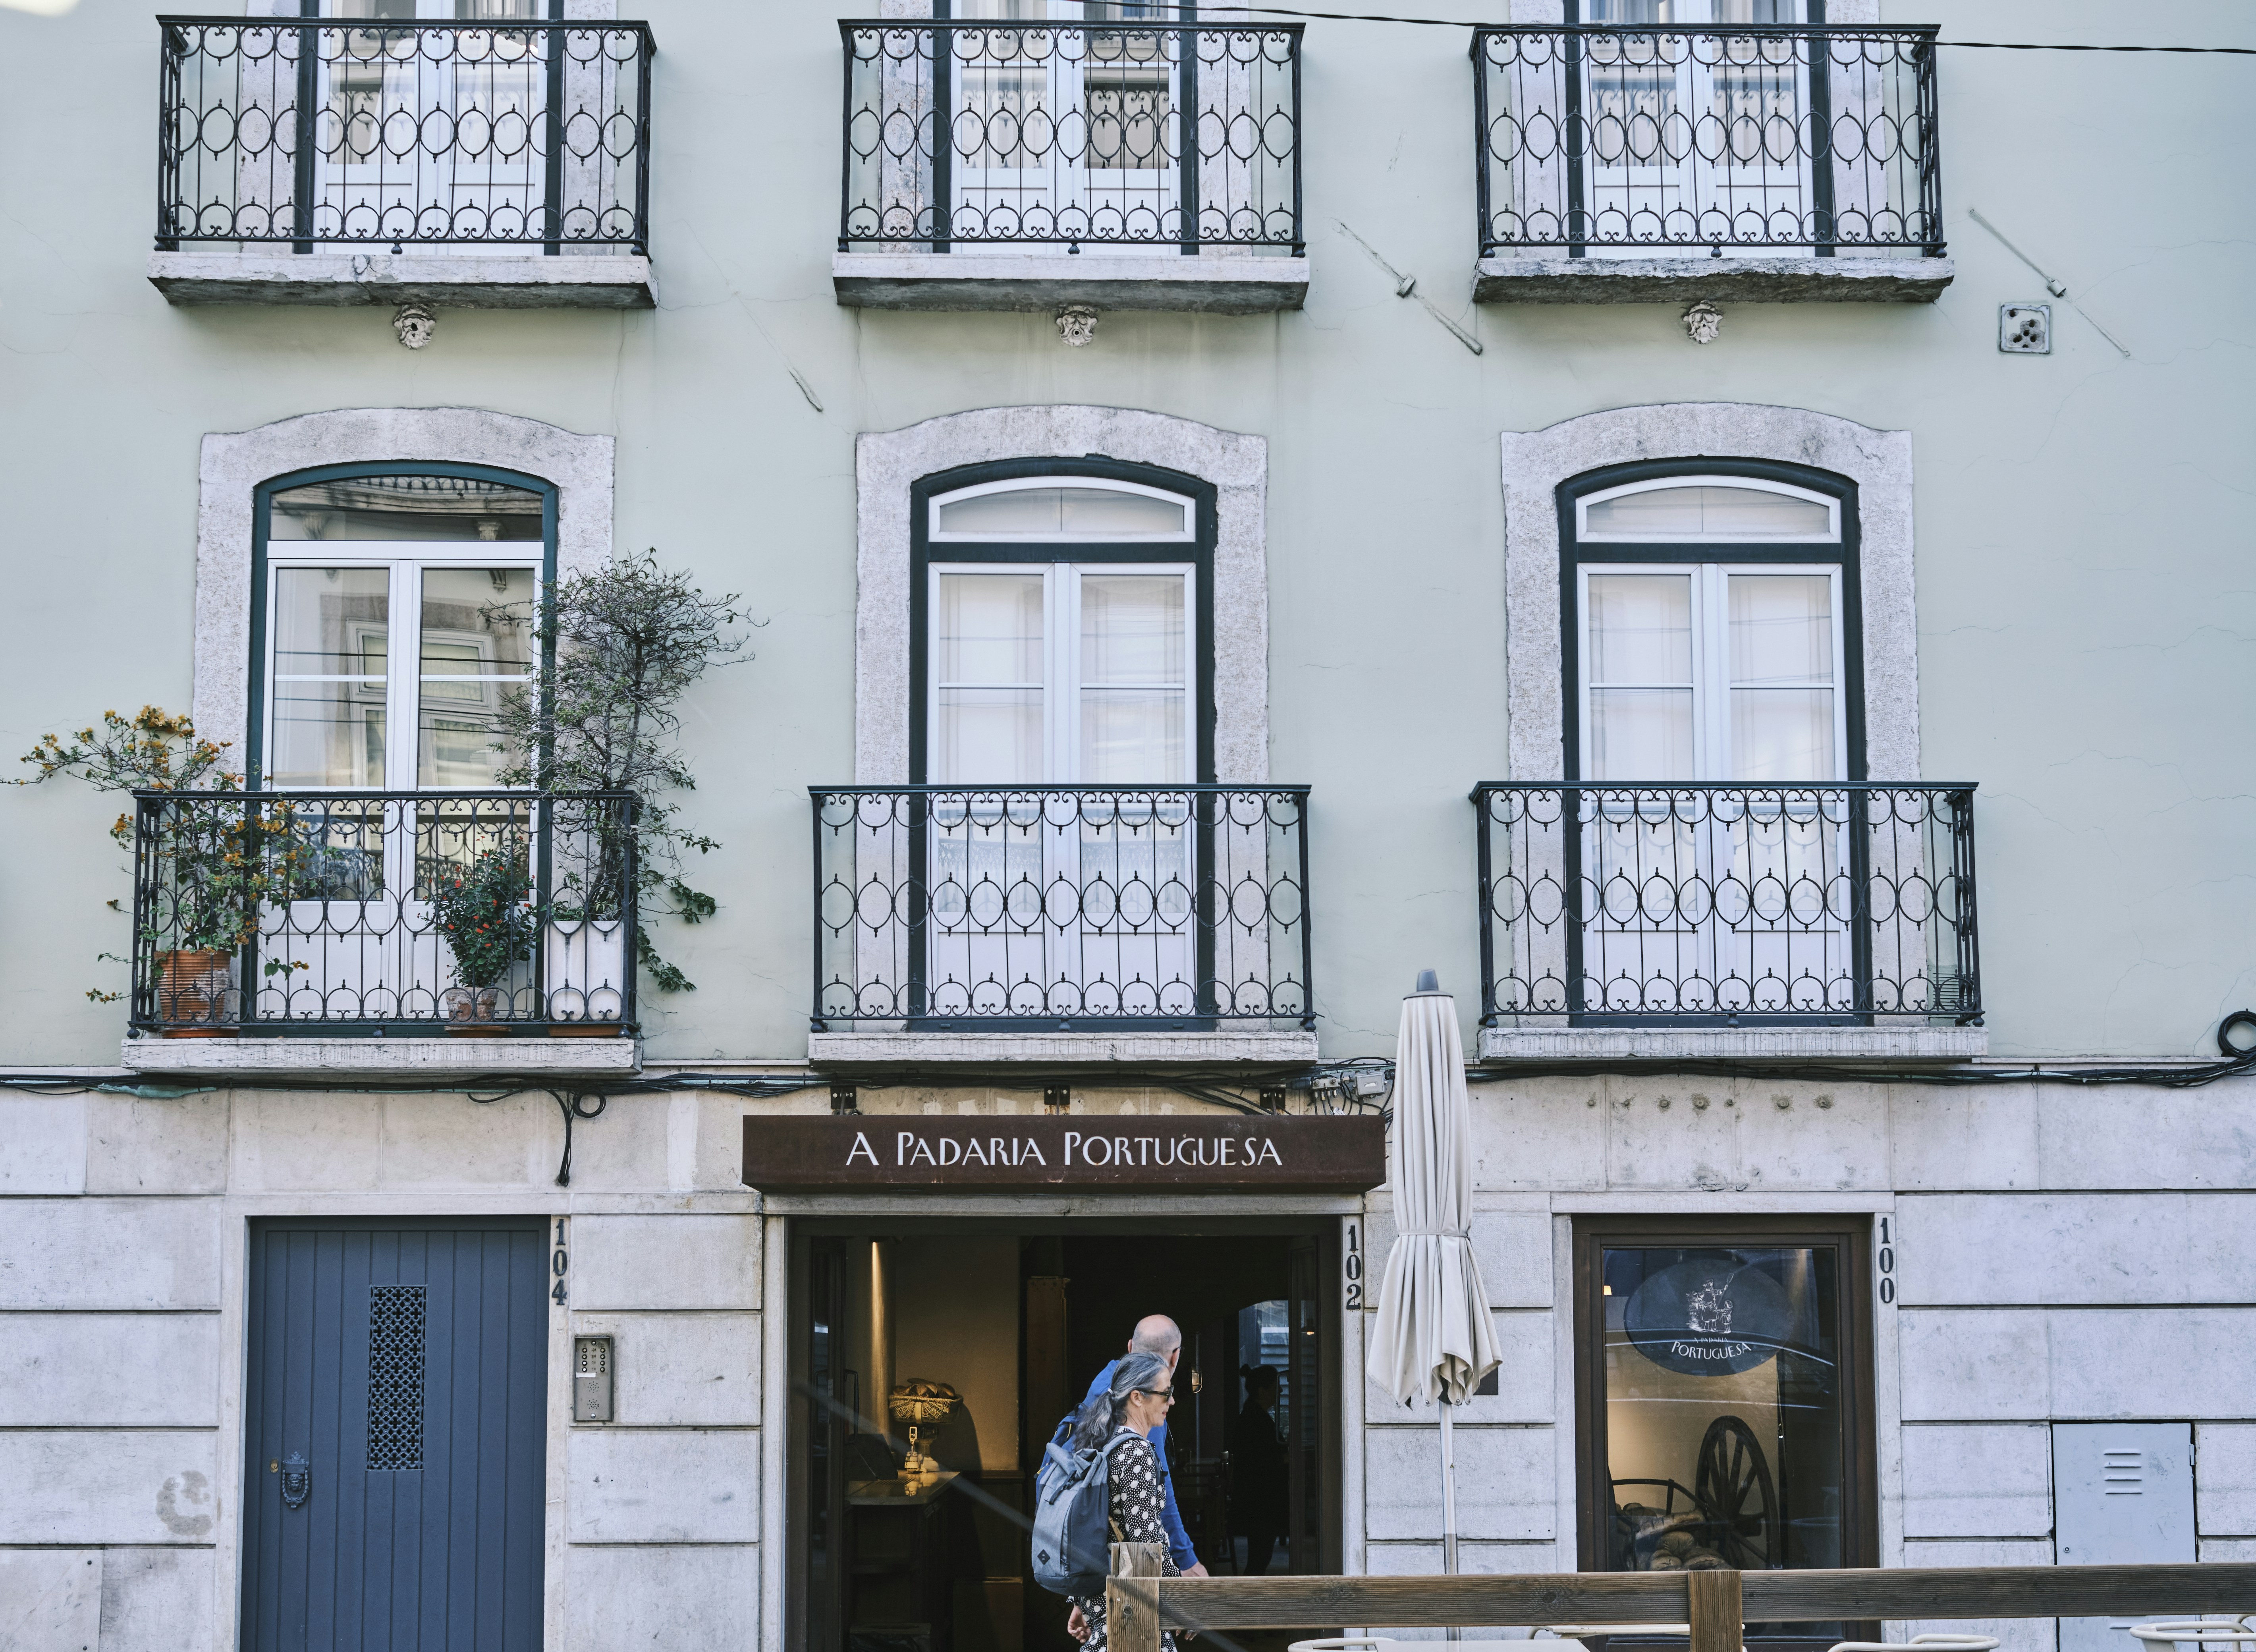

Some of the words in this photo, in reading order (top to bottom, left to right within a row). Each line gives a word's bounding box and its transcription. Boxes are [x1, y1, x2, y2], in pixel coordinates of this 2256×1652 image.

[846, 1132, 879, 1166] A
[897, 1132, 1046, 1166] PADARIA
[1065, 1132, 1282, 1166] PORTUGUESA
[552, 1219, 567, 1306] 104
[1346, 1225, 1361, 1310] 102
[1879, 1218, 1894, 1303] 100
[1671, 1340, 1752, 1360] PORTUGUESA
